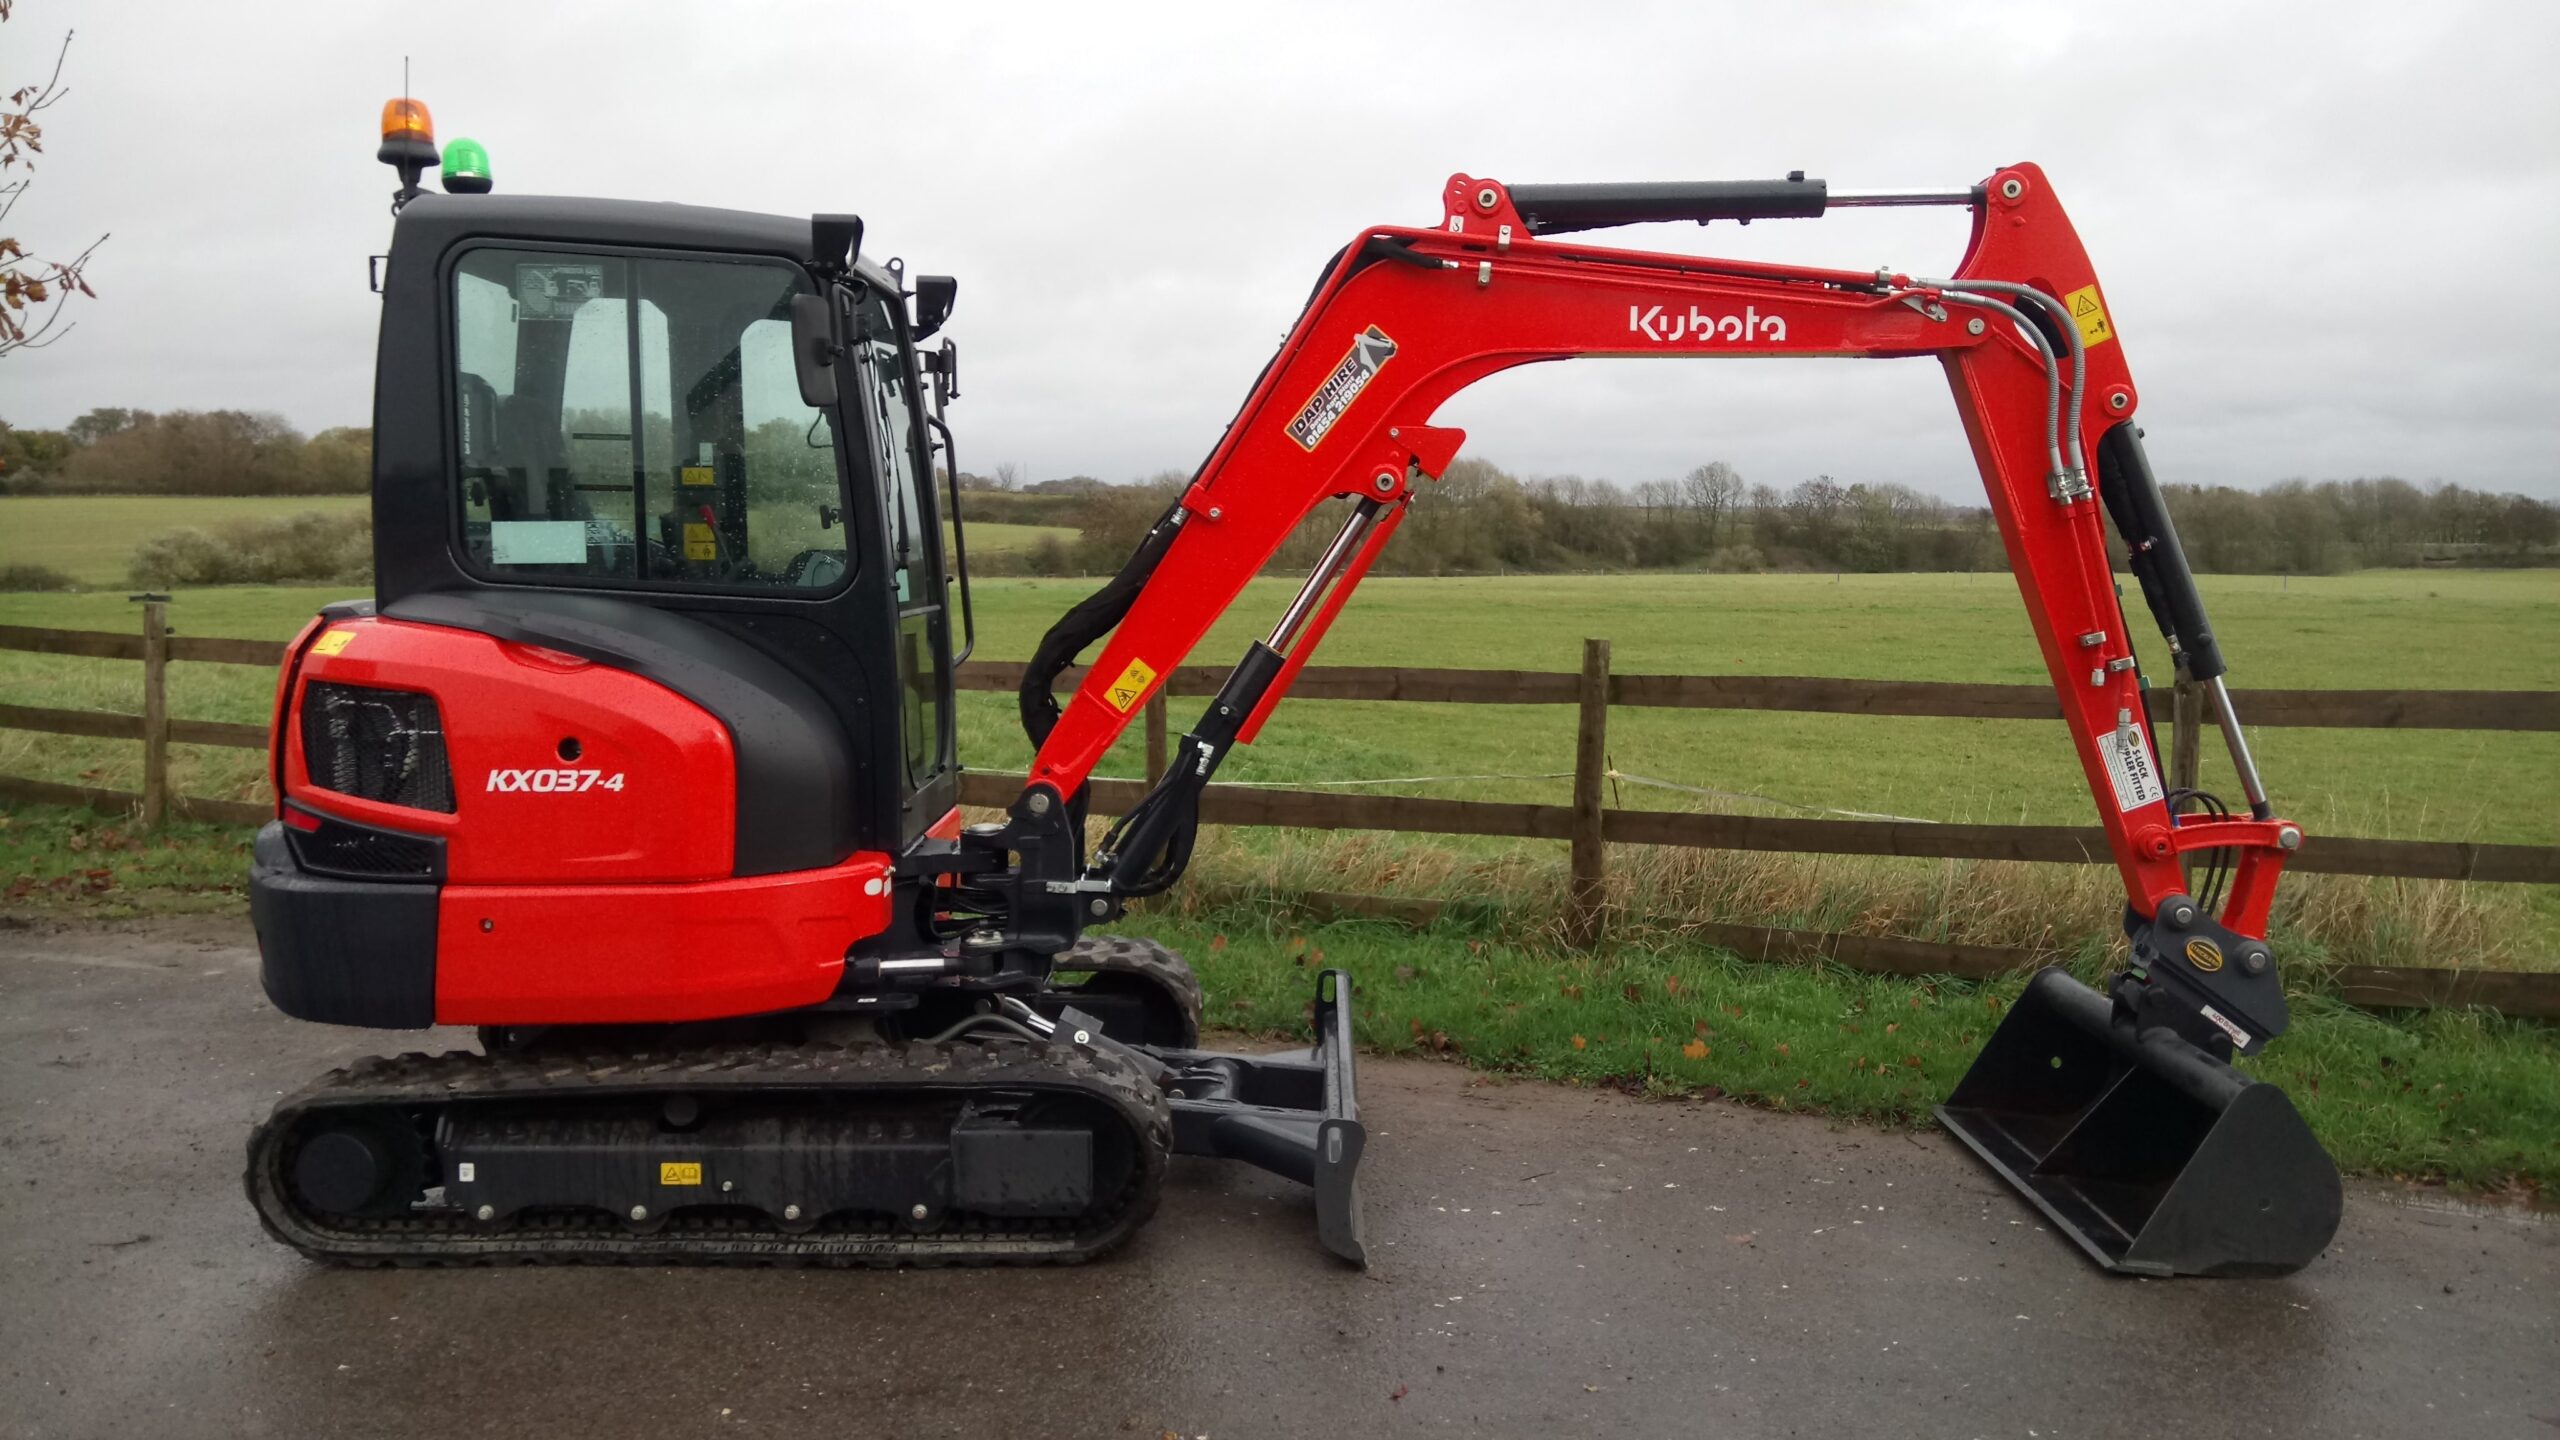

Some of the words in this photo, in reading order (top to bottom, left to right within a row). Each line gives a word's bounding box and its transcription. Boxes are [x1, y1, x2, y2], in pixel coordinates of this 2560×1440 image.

[1629, 305, 1787, 342] Kubota
[1293, 396, 1324, 435] DAP
[1323, 357, 1358, 400] HIRE
[1306, 410, 1336, 446] 01454
[1335, 369, 1370, 412] 219054
[486, 769, 625, 792] KX037-4
[2132, 749, 2149, 779] S-LOCK
[2130, 773, 2146, 801] FITTED
